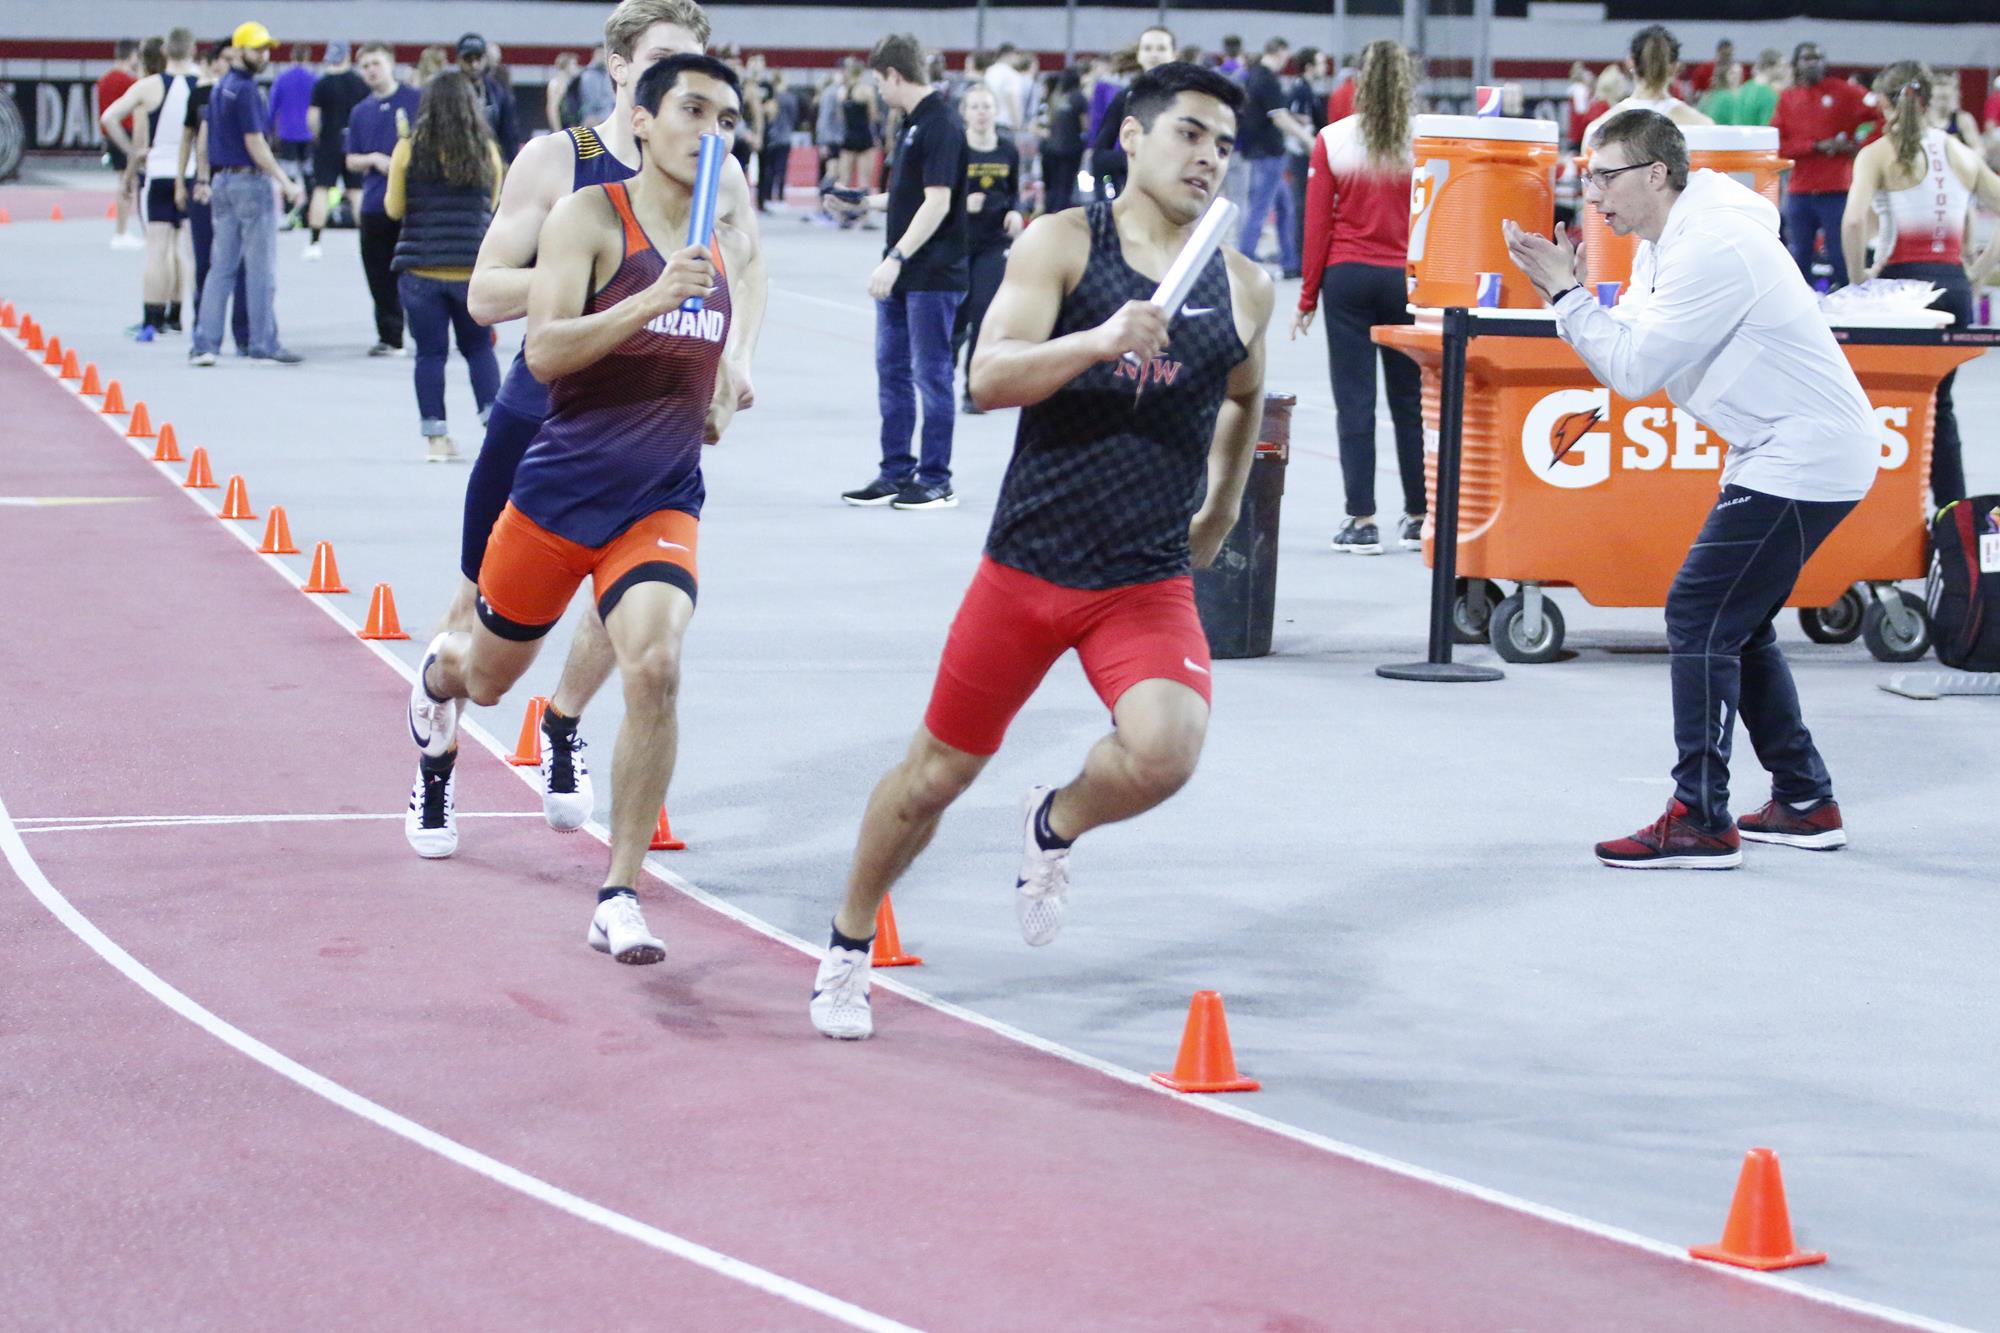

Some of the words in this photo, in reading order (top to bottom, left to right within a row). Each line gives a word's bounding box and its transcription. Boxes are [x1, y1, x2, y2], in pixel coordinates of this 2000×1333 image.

[643, 308, 724, 342] DLAND
[1522, 388, 1610, 488] G
[1622, 406, 1909, 471] SES
